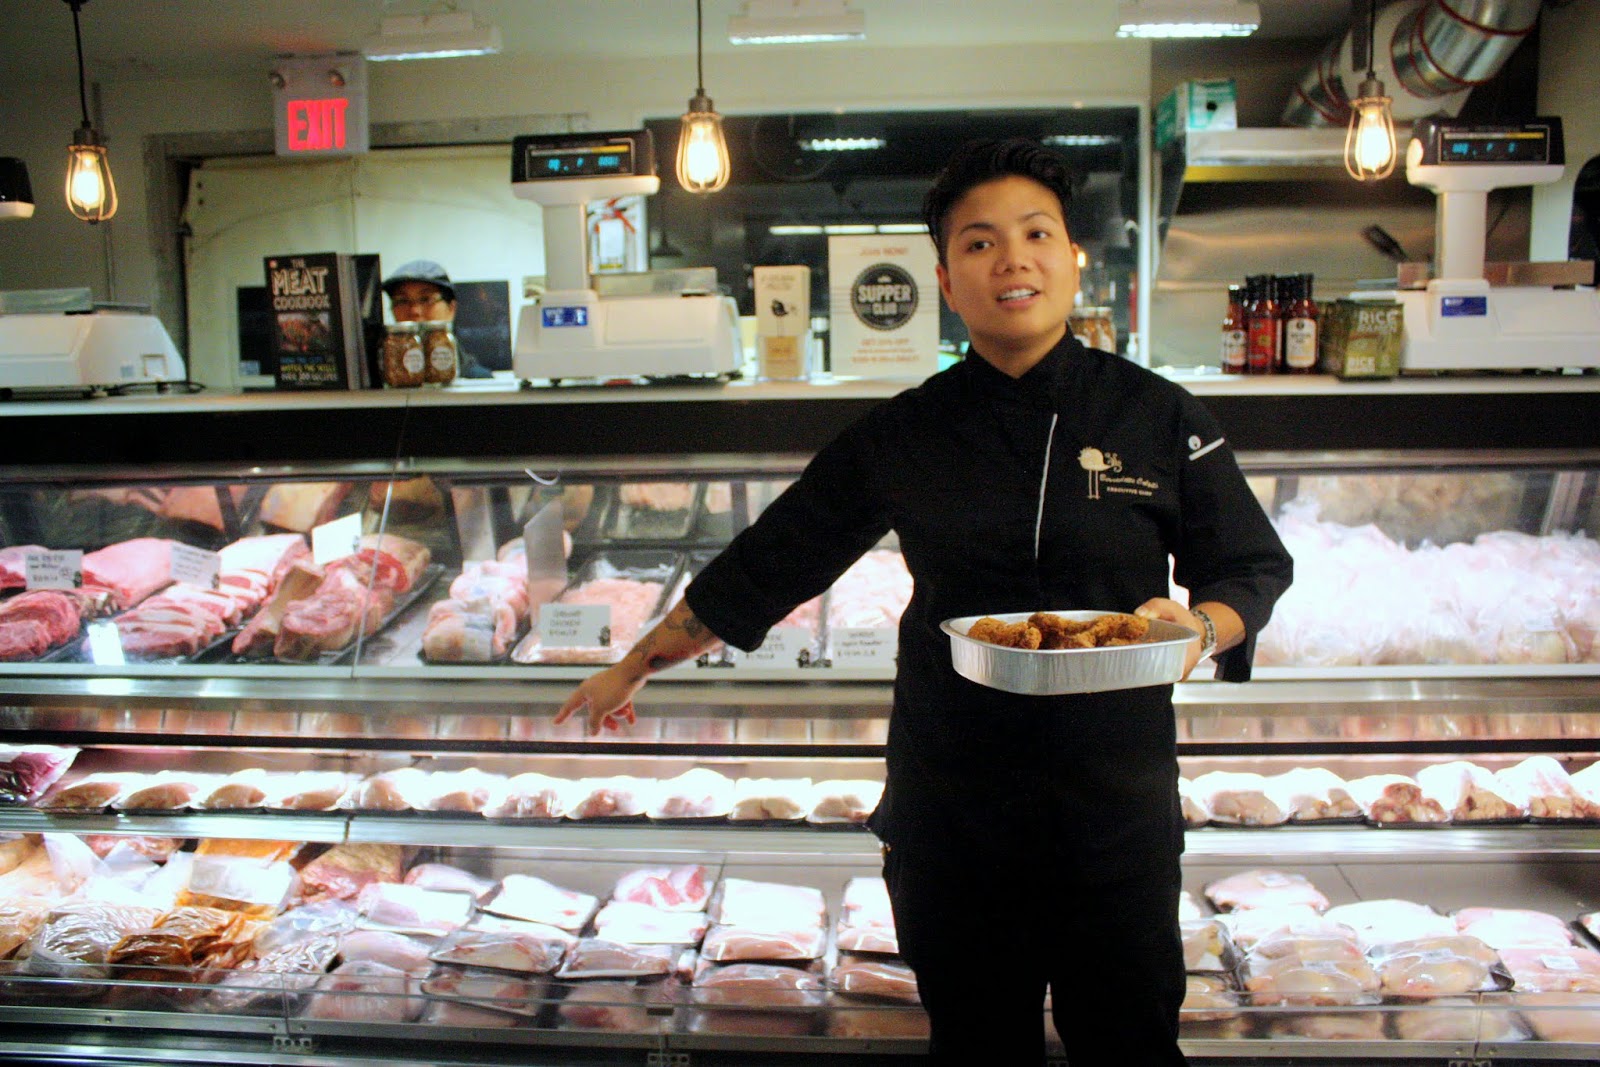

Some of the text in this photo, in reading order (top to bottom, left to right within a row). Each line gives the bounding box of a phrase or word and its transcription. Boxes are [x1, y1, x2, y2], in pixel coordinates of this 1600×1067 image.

[287, 97, 349, 150] EXIT
[272, 267, 328, 295] MEAT
[273, 294, 330, 310] COOKBOOK
[858, 284, 912, 303] SUPPER
[872, 302, 898, 315] CLUB
[1359, 309, 1400, 323] RICE
